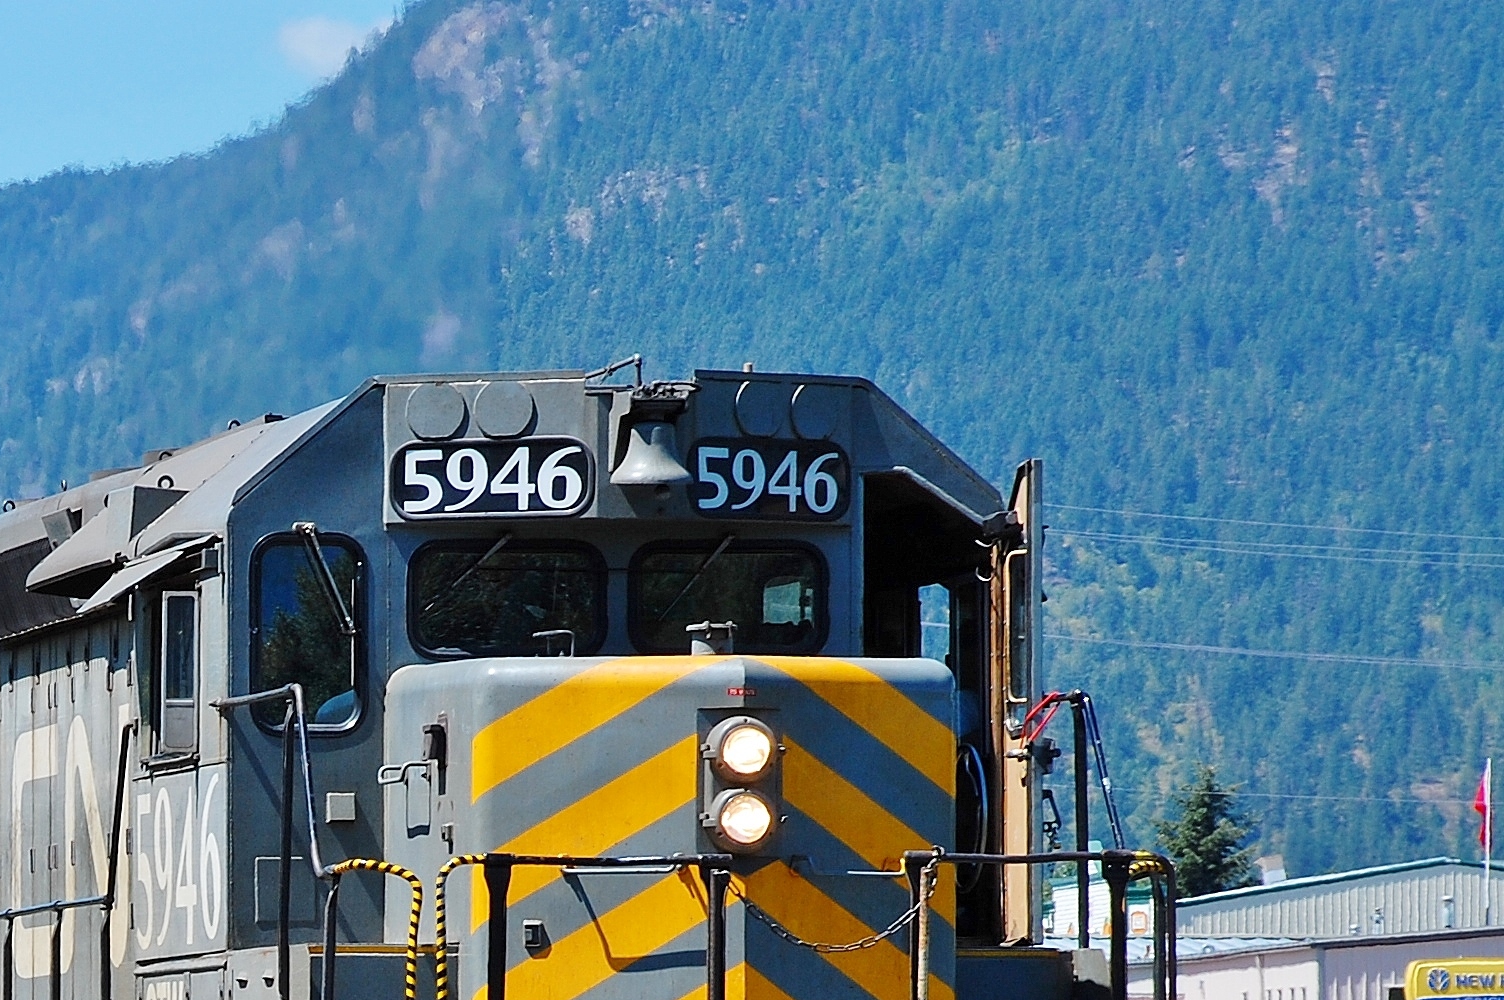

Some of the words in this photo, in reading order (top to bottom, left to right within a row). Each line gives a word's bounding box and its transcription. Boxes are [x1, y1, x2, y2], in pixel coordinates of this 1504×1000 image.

[404, 445, 583, 512] 5946
[697, 446, 839, 514] 5946
[12, 703, 130, 979] CN
[136, 773, 222, 950] 5946
[1456, 974, 1495, 988] NEW
